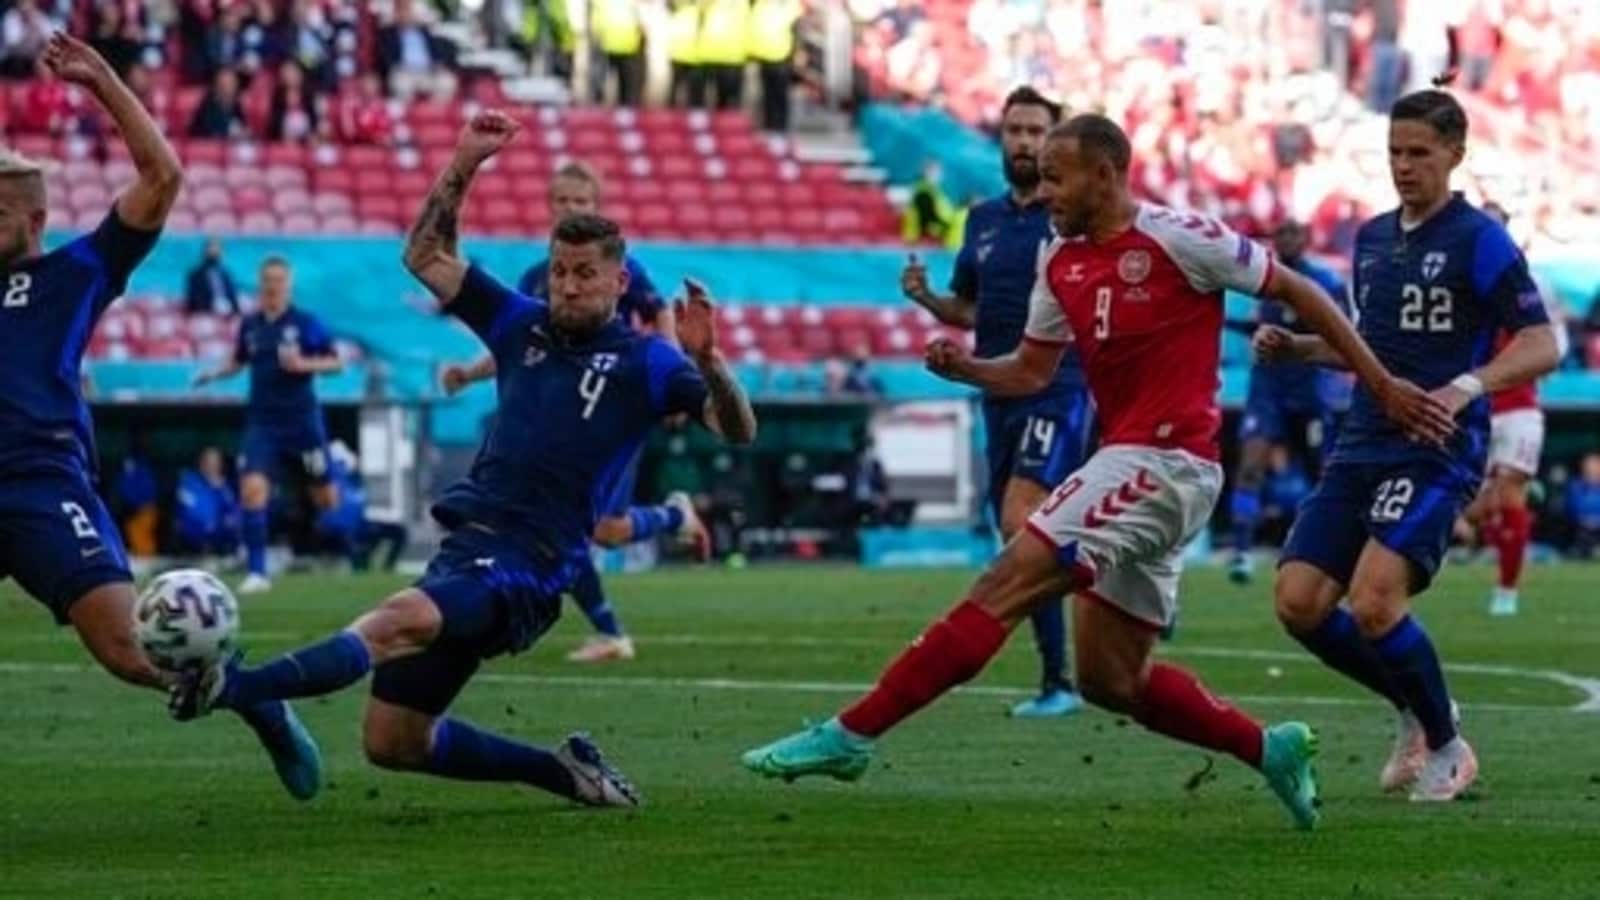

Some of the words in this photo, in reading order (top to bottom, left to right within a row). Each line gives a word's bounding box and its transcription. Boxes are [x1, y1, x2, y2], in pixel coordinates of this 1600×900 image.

[3, 272, 32, 308] 2
[1400, 284, 1453, 331] 22
[1095, 286, 1112, 340] 9
[578, 368, 607, 419] 4
[1020, 415, 1056, 454] 14
[62, 501, 100, 539] 2
